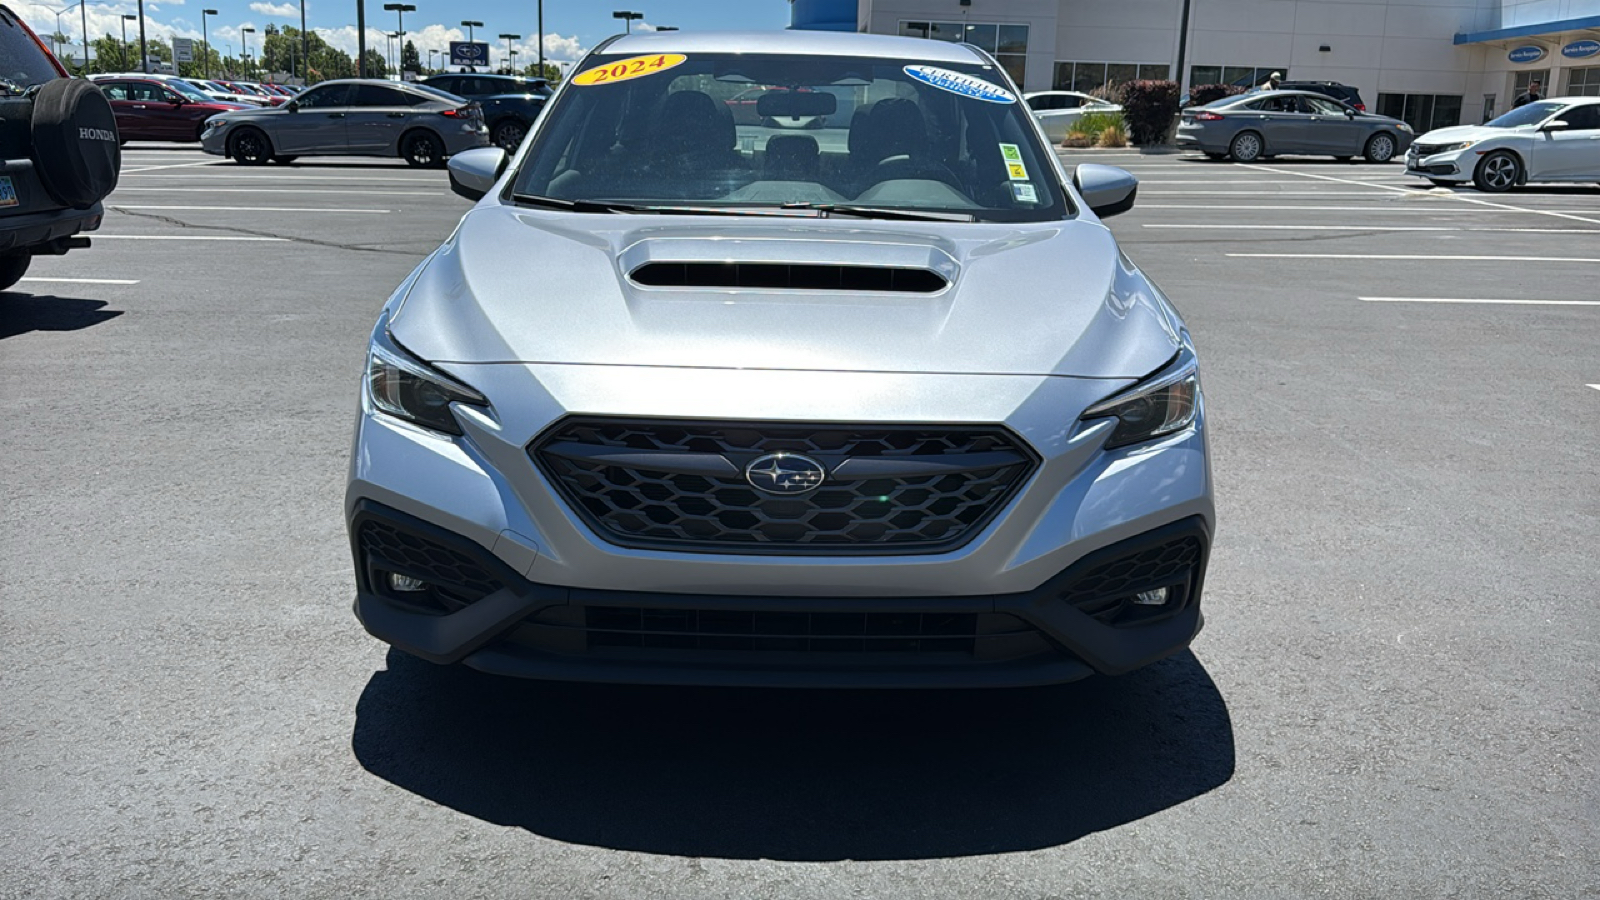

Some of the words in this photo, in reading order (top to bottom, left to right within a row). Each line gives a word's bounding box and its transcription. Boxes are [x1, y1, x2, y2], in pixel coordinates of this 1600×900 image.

[593, 55, 666, 82] 2024
[919, 66, 1006, 96] CERTIFIED
[79, 127, 116, 141] HONDA
